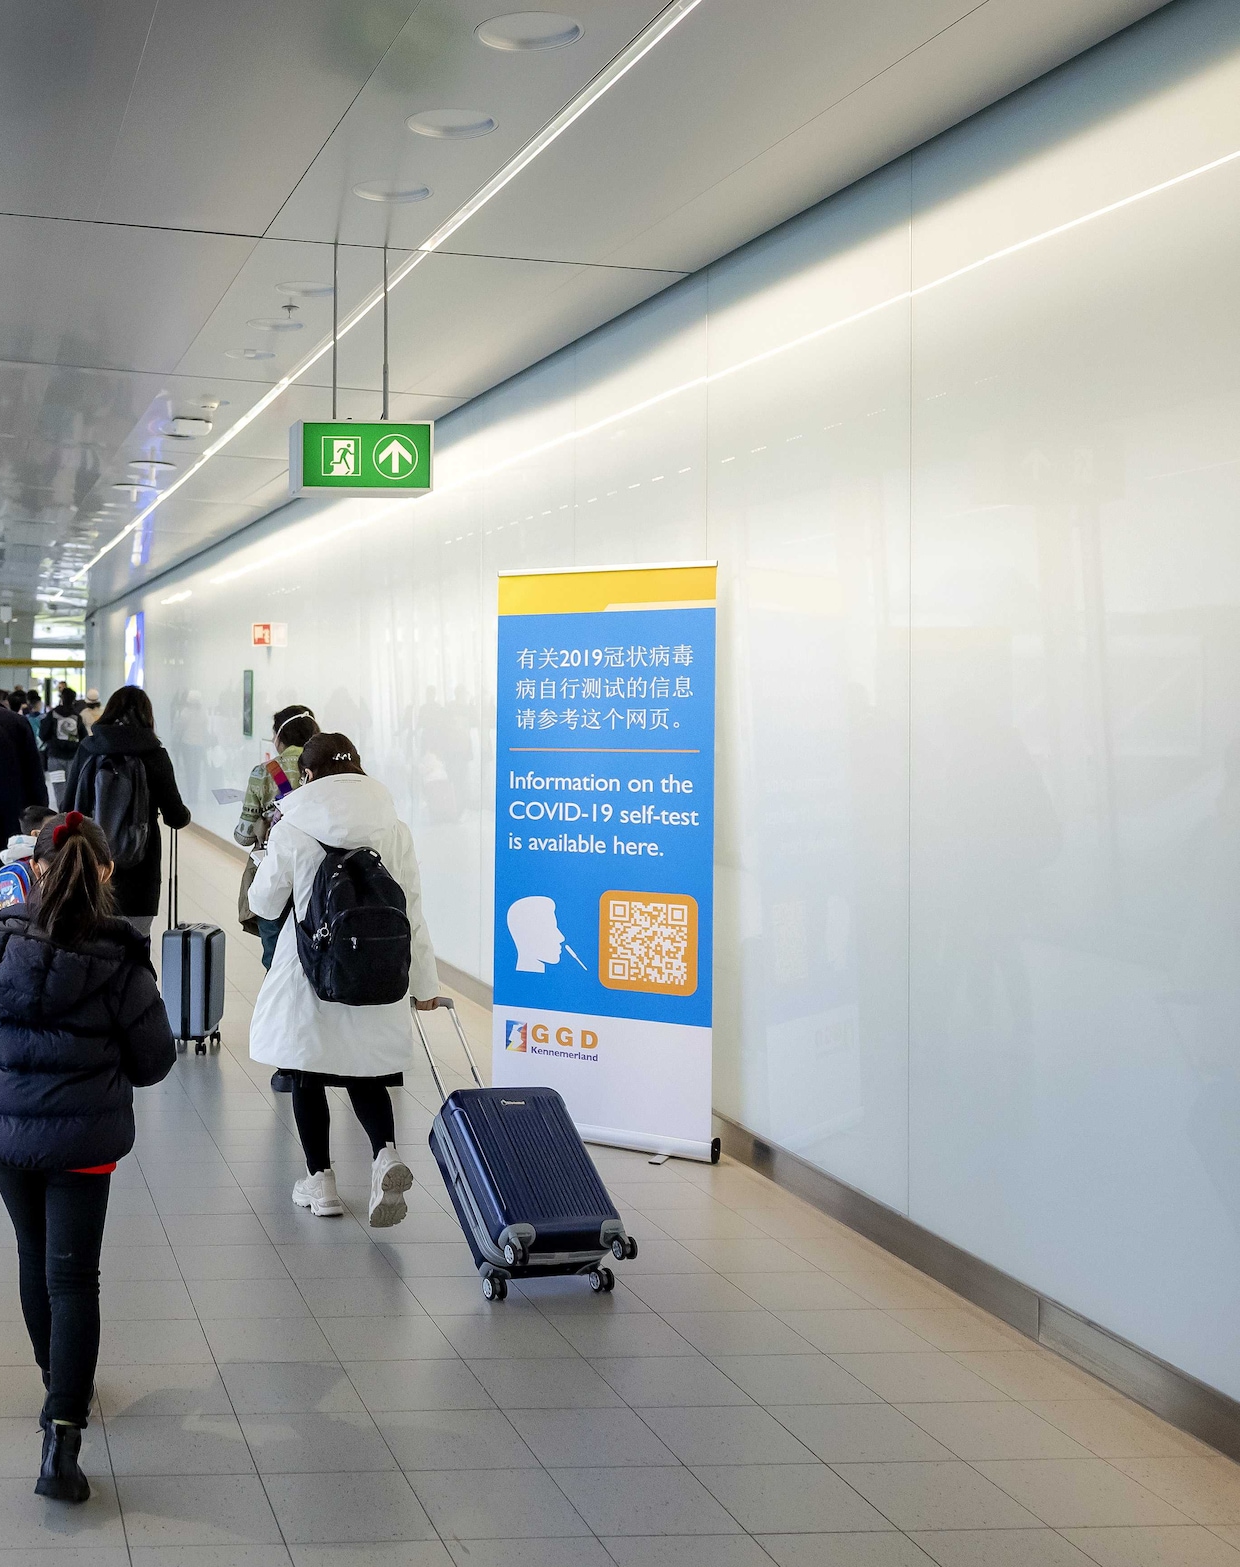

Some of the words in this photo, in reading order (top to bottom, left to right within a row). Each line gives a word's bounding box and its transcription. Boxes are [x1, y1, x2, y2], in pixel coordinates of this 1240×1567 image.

[516, 644, 694, 670] 有关2019冠状病毒
[515, 676, 694, 700] 病自行测试的信息
[515, 707, 681, 731] 请参考这个网页。
[509, 771, 621, 792] Information
[628, 777, 654, 793] on
[660, 774, 693, 794] the
[509, 801, 613, 823] COVID-19
[620, 806, 699, 827] self-test
[509, 833, 522, 850] is
[528, 835, 607, 854] available
[613, 836, 664, 857] here.
[531, 1023, 599, 1049] GGD
[530, 1046, 599, 1062] Kennemerland
